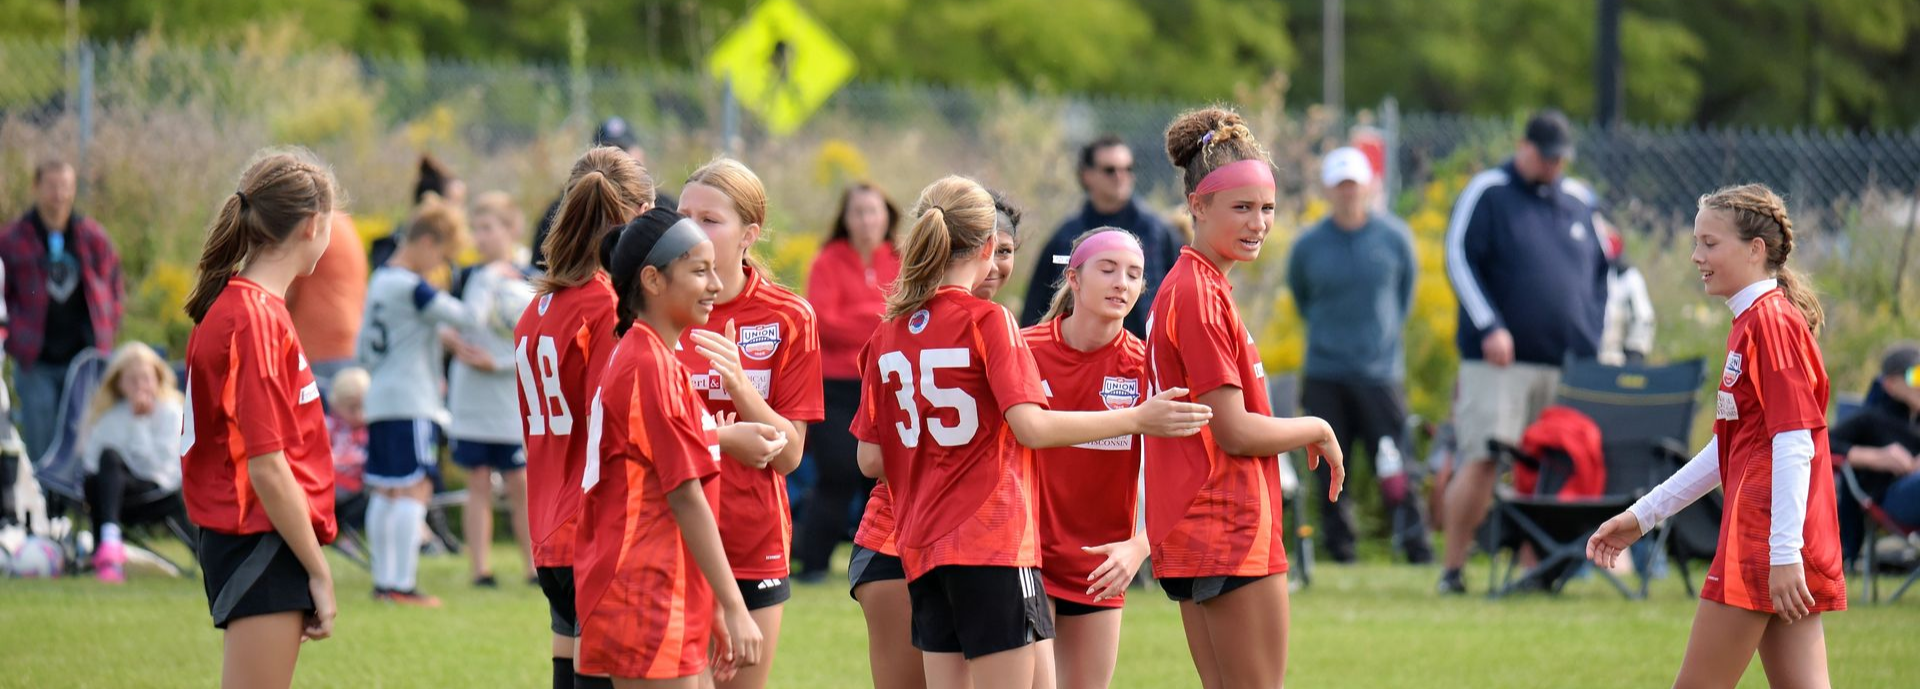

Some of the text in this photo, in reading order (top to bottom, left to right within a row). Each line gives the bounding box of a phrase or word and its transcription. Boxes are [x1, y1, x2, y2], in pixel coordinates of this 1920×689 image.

[744, 328, 775, 340] UNION
[515, 335, 574, 436] 18
[878, 347, 979, 449] 35
[1106, 382, 1135, 392] UNION
